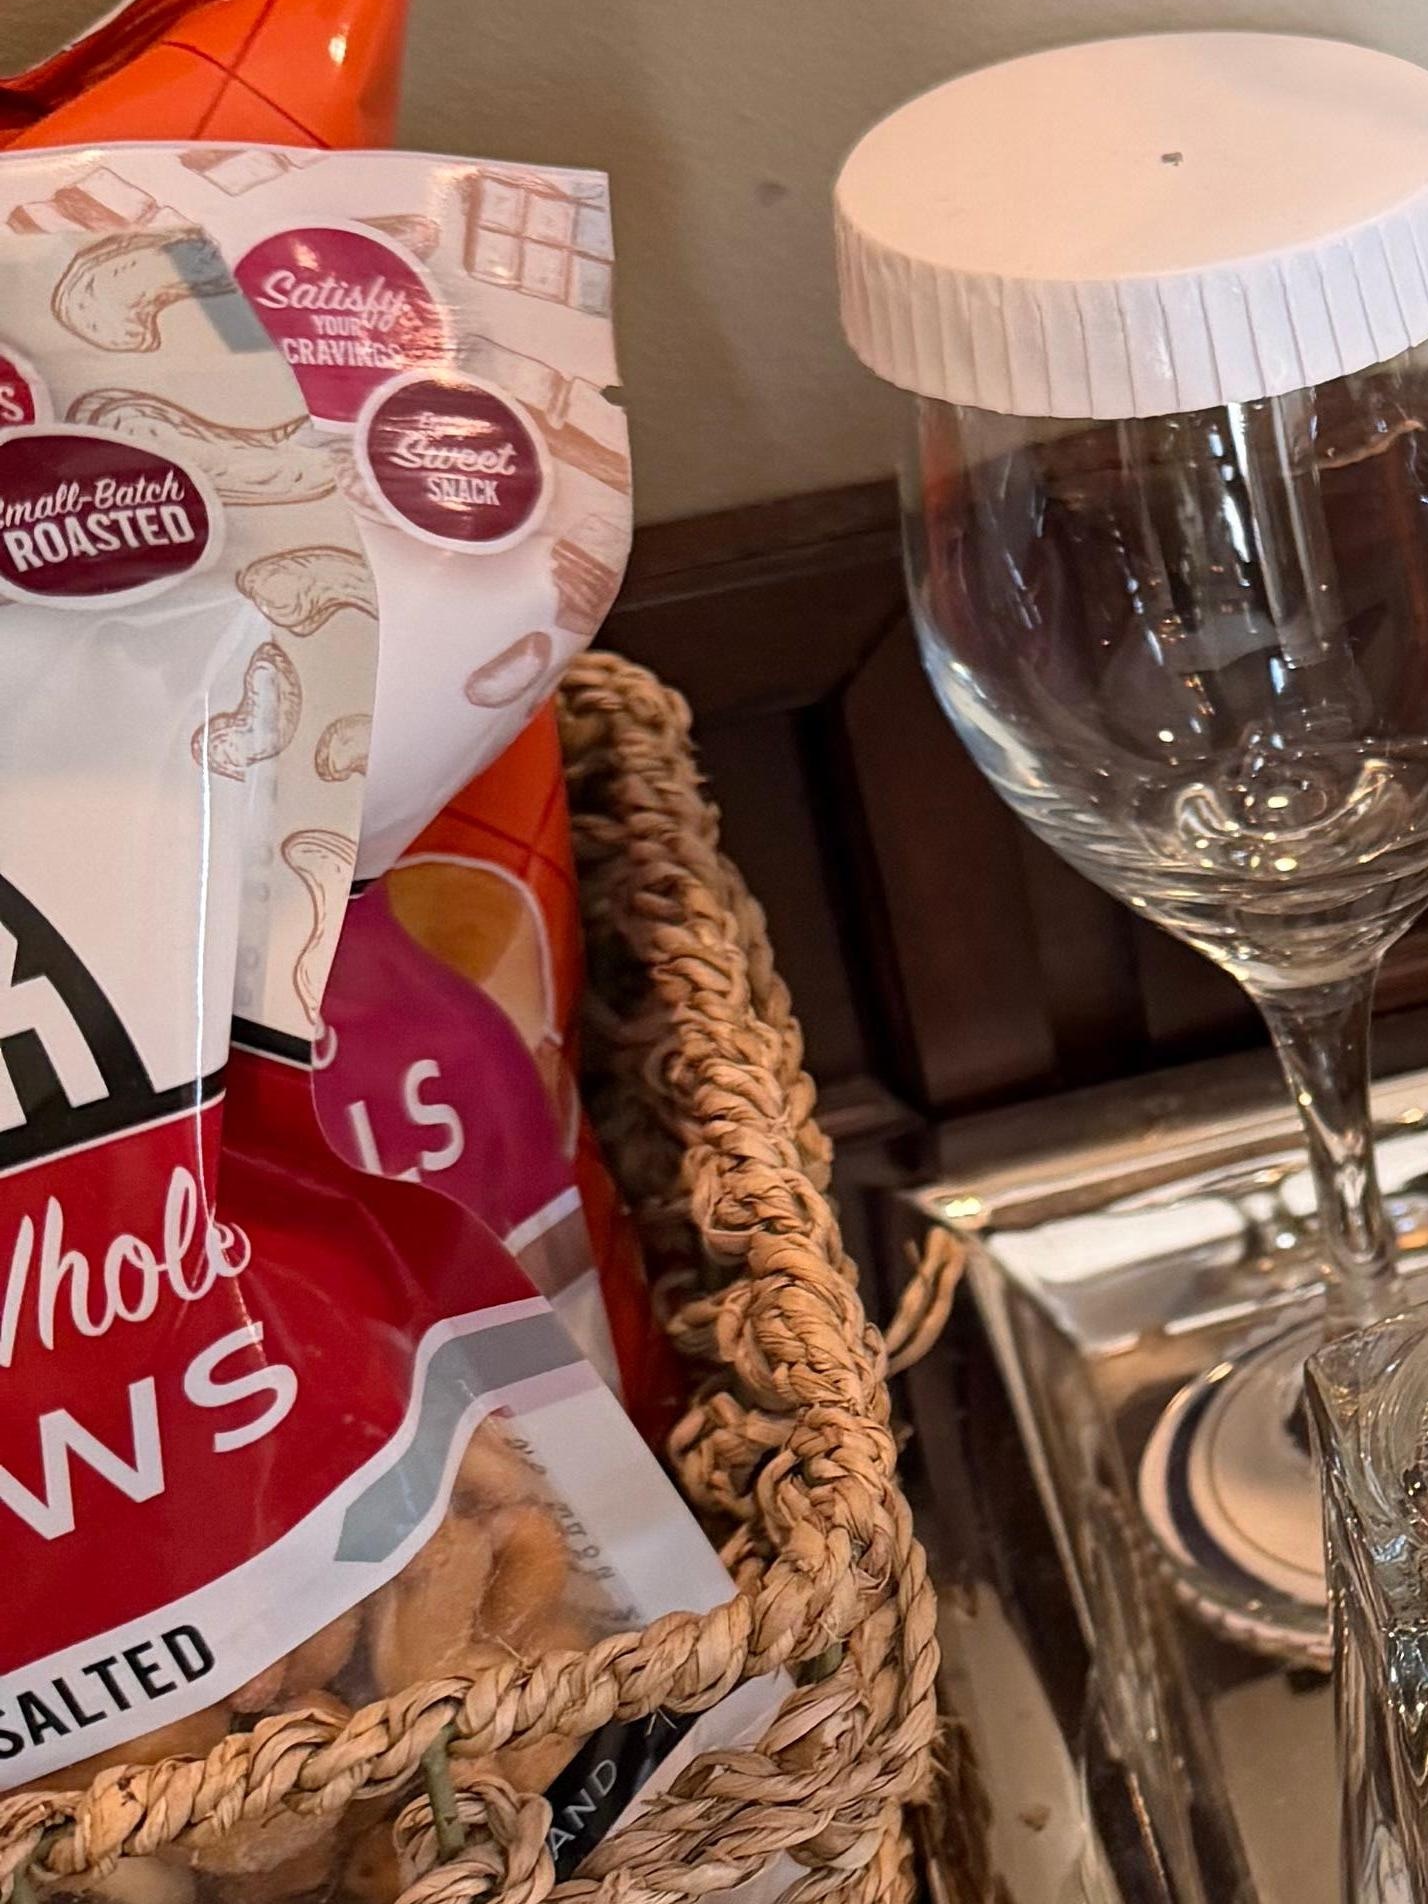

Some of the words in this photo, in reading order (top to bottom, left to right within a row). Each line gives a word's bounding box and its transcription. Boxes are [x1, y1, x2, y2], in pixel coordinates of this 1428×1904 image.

[255, 270, 406, 331] Satisfy
[311, 314, 362, 337] YOUR
[282, 337, 402, 369] CRAVINGS
[387, 434, 516, 475] Sweet
[427, 475, 500, 506] SNACK
[3, 504, 195, 573] ROASTED
[549, 1758, 618, 1861] AND
